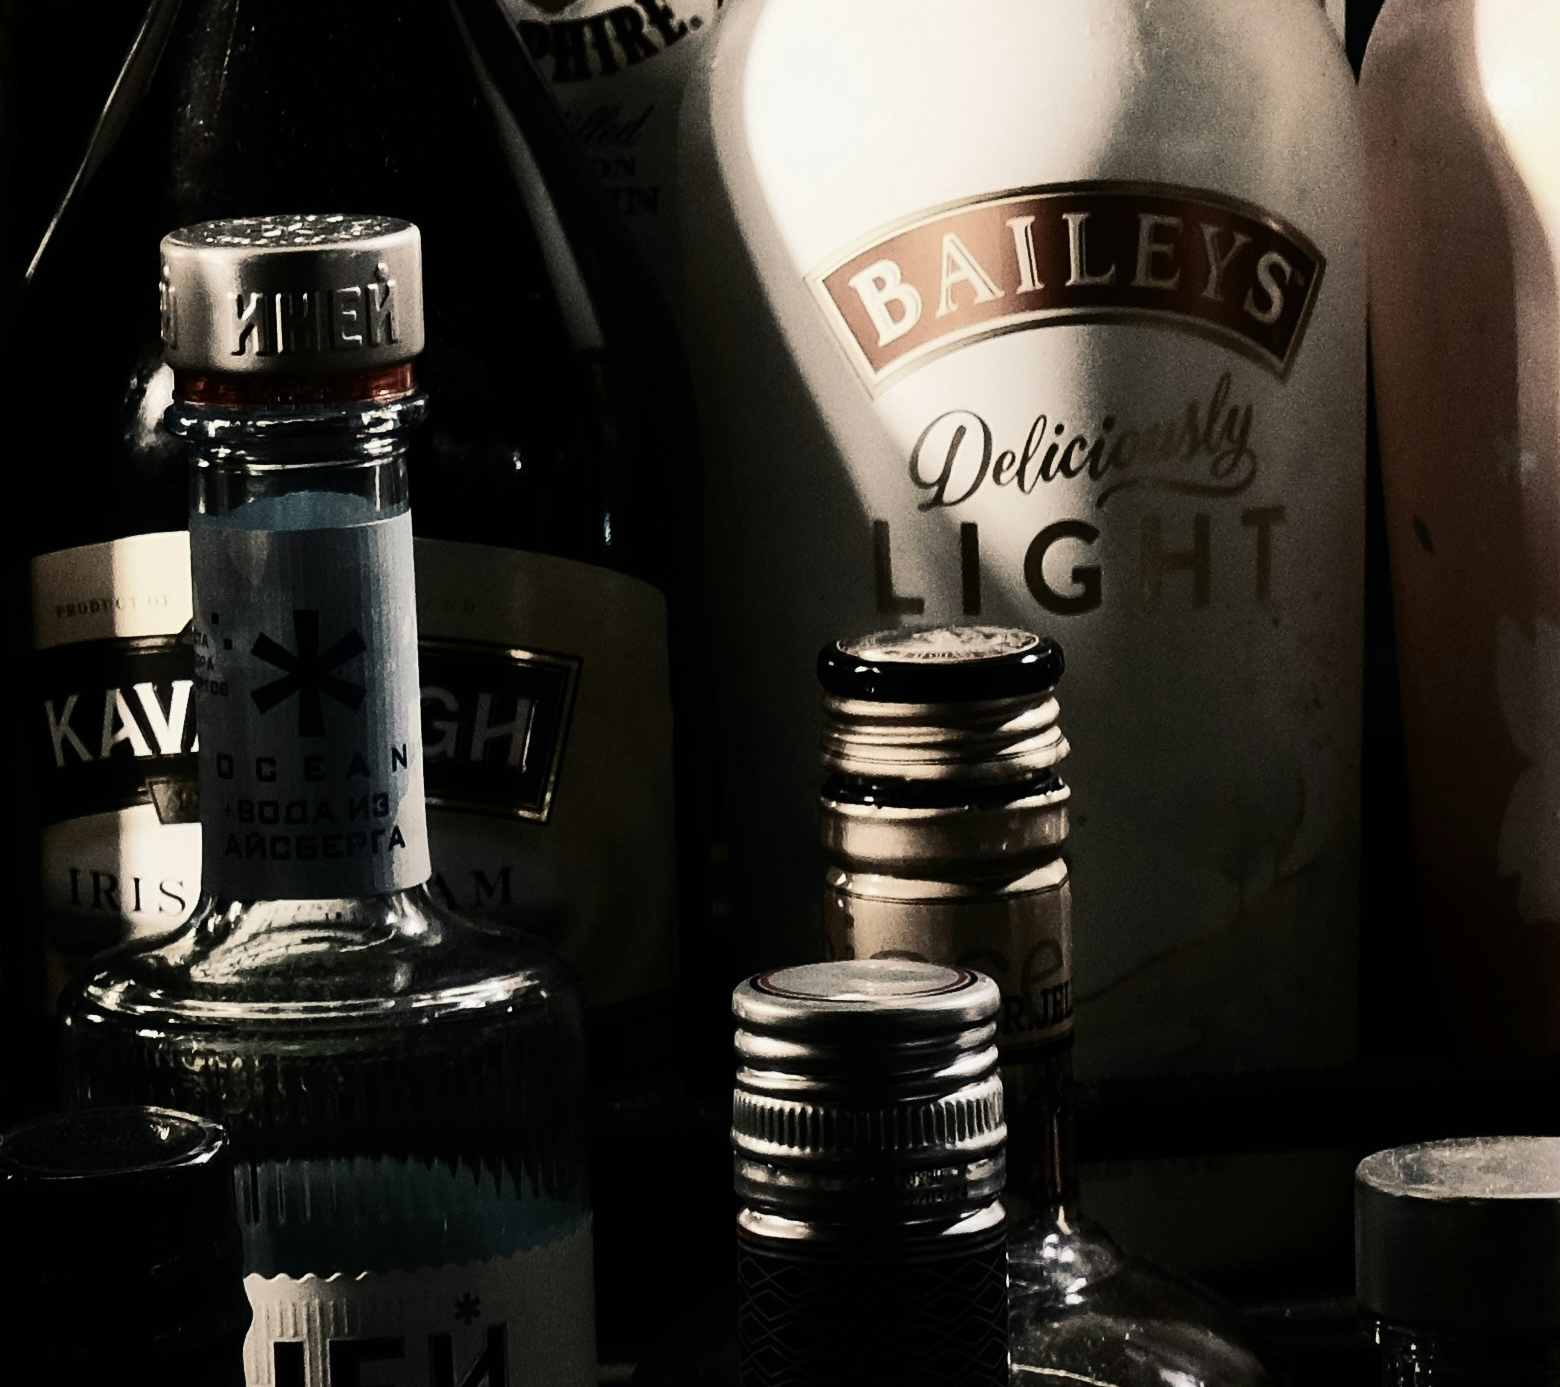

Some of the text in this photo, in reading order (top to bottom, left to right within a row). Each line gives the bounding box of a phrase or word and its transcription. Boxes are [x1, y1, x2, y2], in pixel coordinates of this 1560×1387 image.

[230, 261, 400, 357] ИНЕЙ
[851, 199, 1300, 348] BAILEYS
[908, 370, 1259, 514] Deliciously
[871, 505, 1288, 617] LIGHT
[216, 743, 408, 782] OCEAN
[347, 792, 390, 819] ИЗ
[224, 826, 406, 861] АЙСБЕРГА
